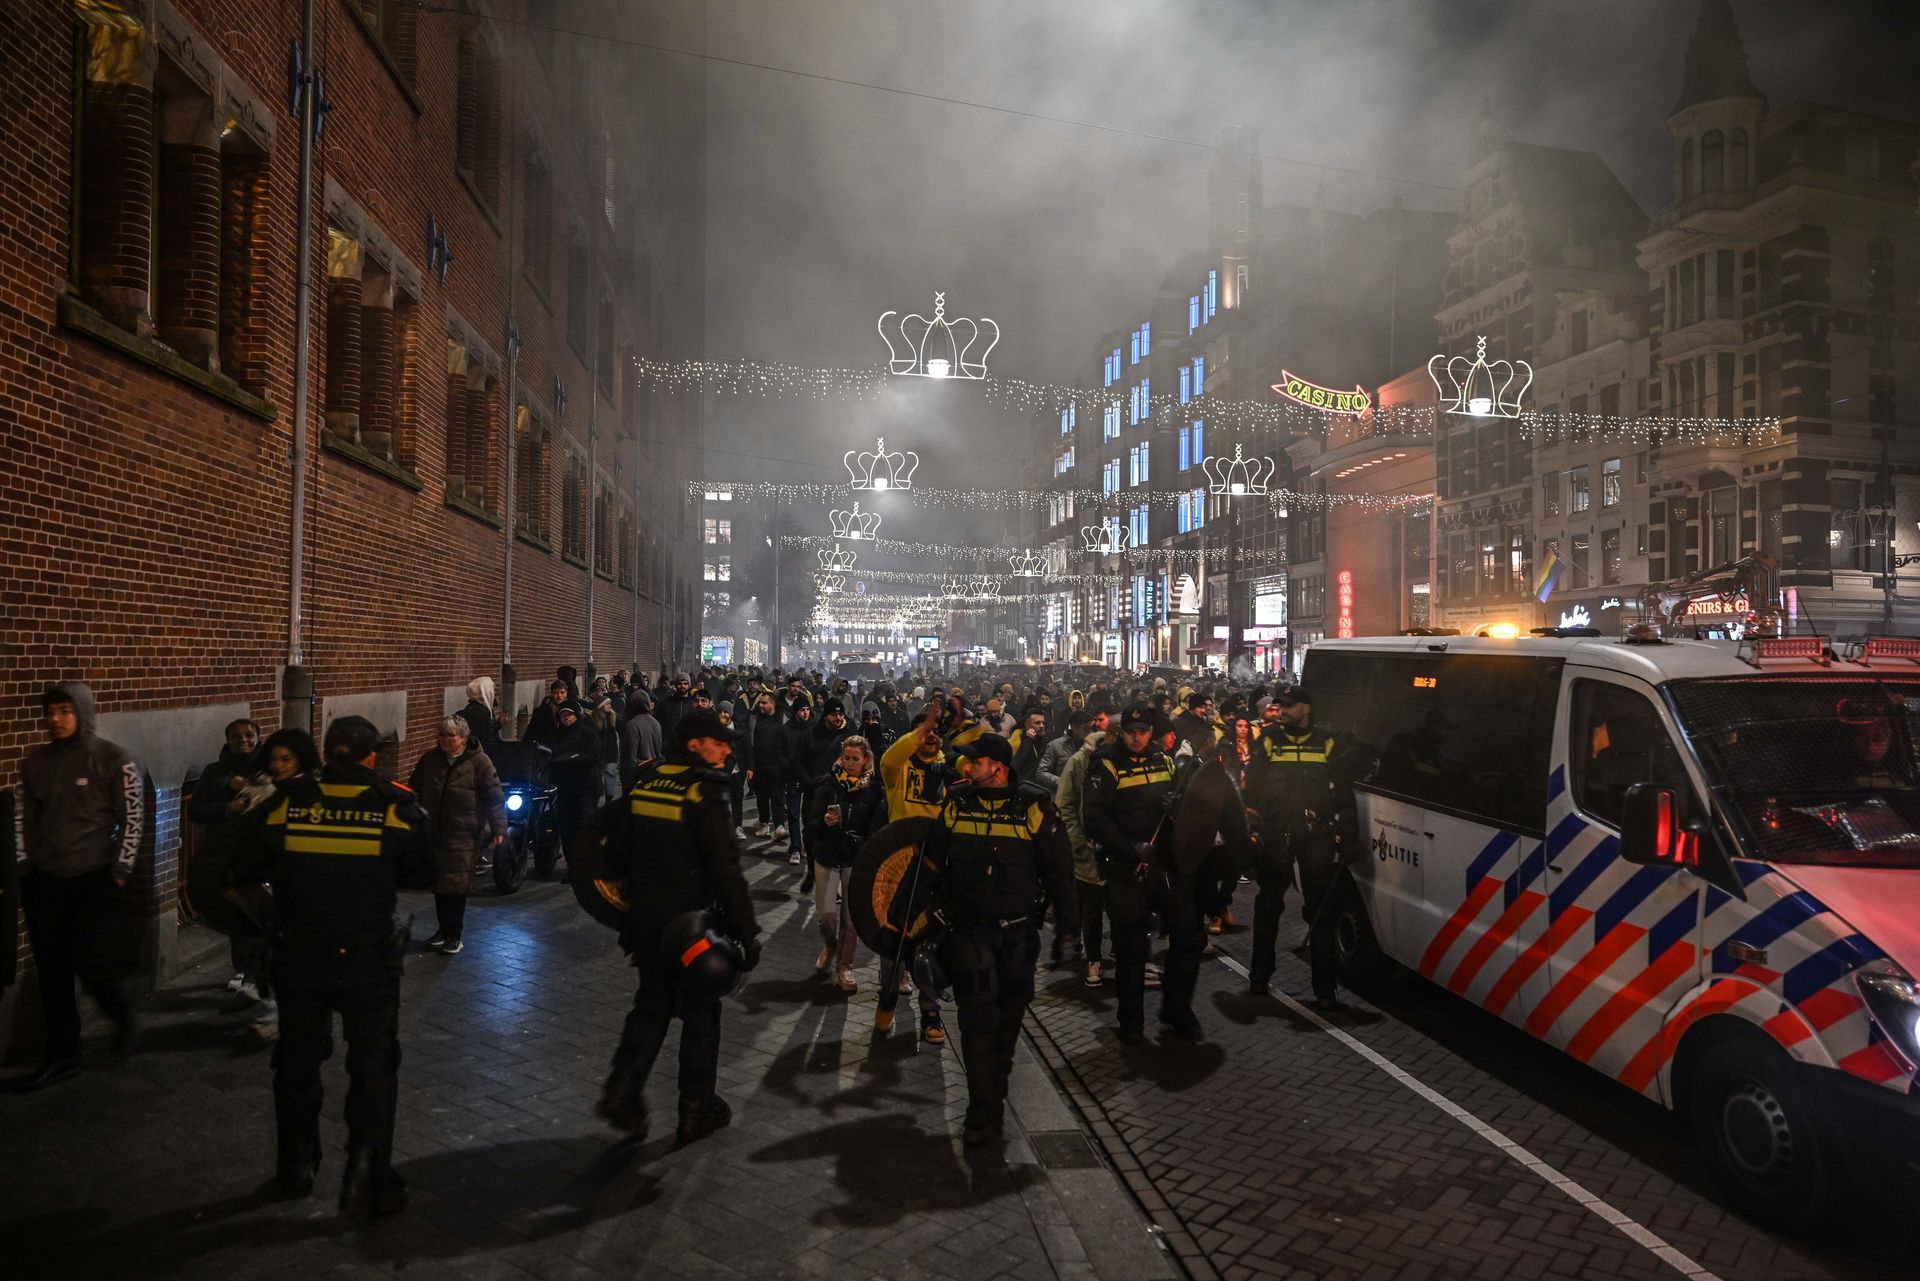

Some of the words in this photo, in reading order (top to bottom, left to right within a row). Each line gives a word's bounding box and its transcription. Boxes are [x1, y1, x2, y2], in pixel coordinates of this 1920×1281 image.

[1287, 380, 1367, 410] CASINO
[1146, 580, 1154, 620] PRIMARK
[1340, 572, 1353, 639] CASINO
[1723, 601, 1733, 613] &
[300, 804, 372, 823] POLITIE
[1372, 837, 1419, 867] POLITIE
